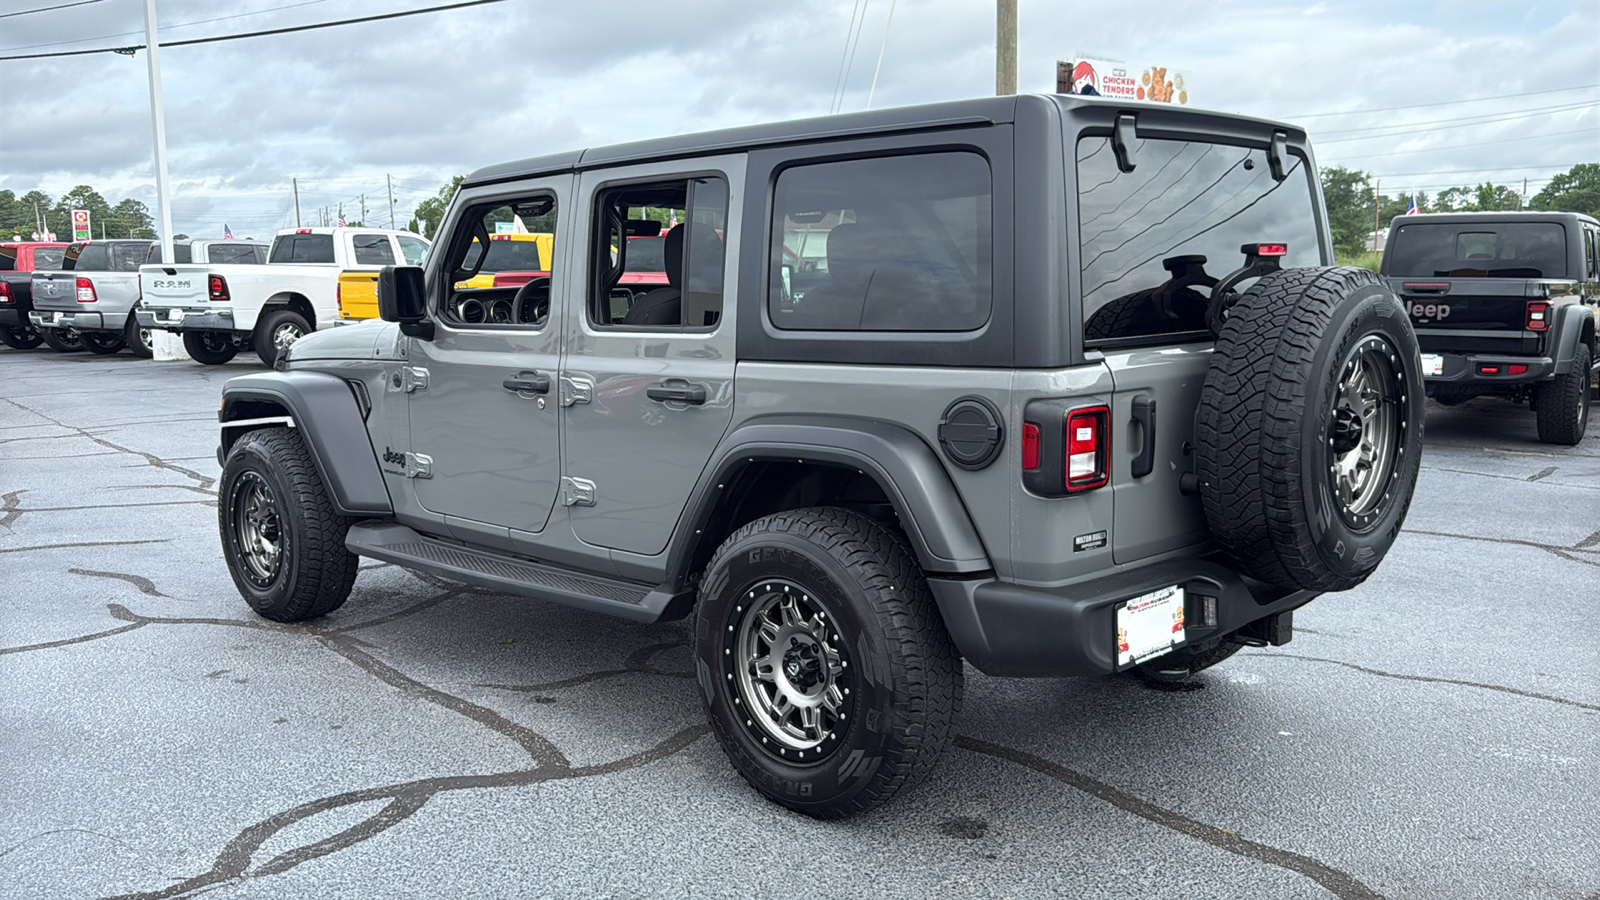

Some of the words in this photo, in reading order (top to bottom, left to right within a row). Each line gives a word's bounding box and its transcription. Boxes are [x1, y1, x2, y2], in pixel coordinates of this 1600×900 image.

[1102, 76, 1136, 86] CHICKEN
[1102, 85, 1135, 95] TENDERS
[153, 279, 191, 288] RAM
[1405, 300, 1451, 321] Jeep
[382, 446, 406, 468] Jeep
[748, 547, 844, 608] GENERAL
